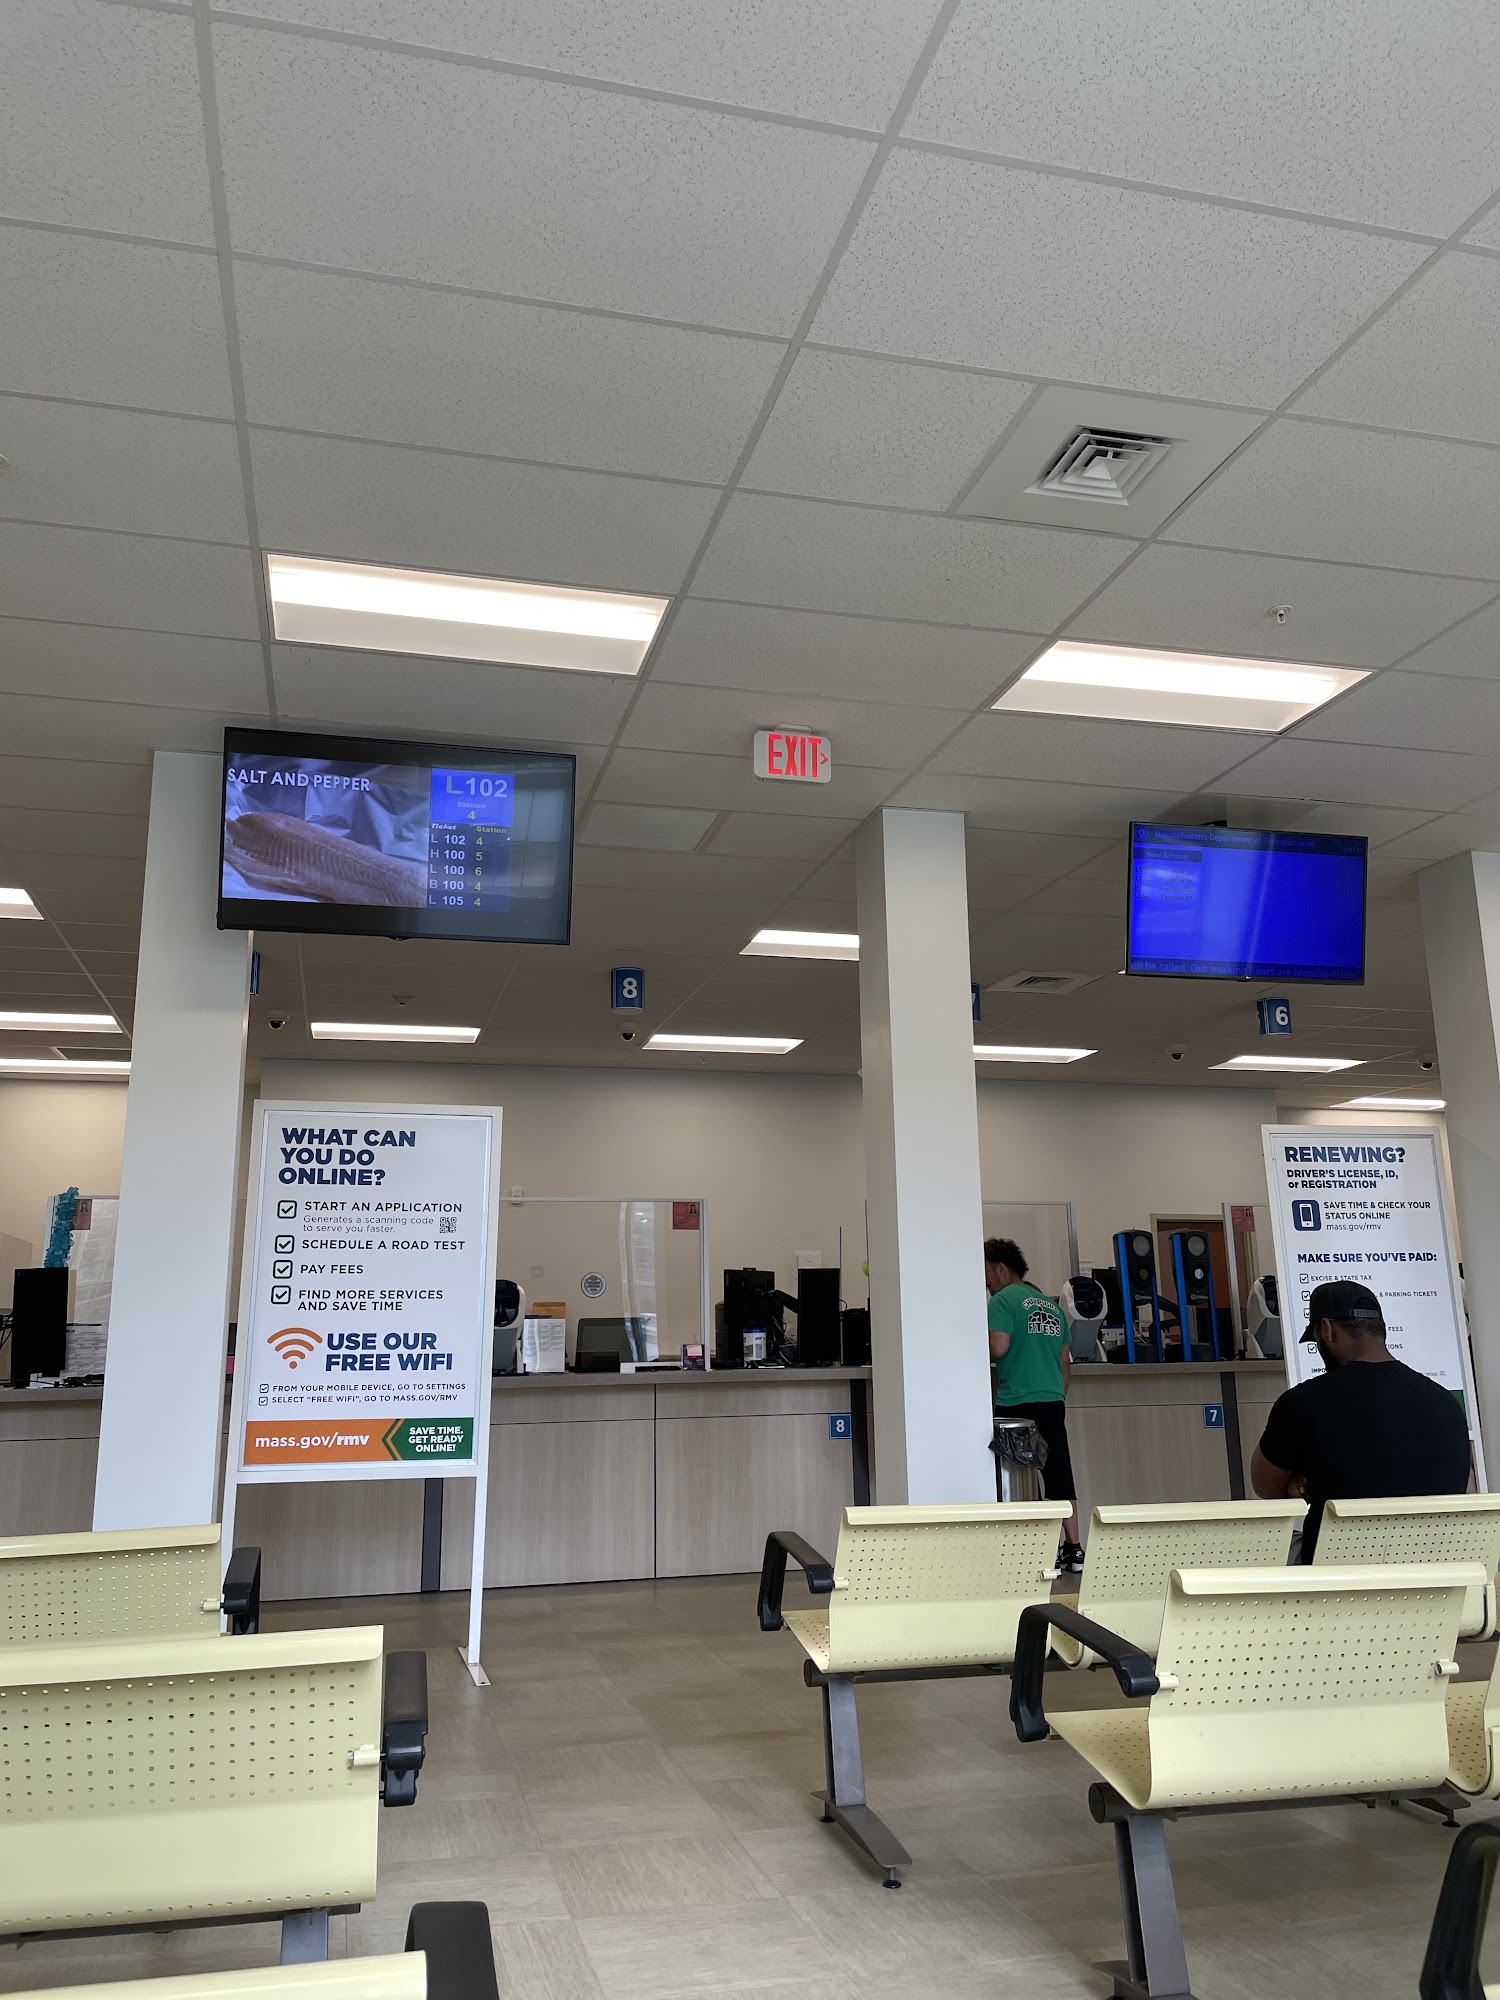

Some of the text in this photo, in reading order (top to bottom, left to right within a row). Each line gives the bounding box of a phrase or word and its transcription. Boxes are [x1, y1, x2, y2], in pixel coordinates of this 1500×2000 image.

[768, 733, 822, 778] EXIT
[228, 768, 370, 792] SALT AND PEPPER
[467, 810, 476, 820] 4
[476, 826, 507, 834] Station
[444, 834, 466, 845] 102
[476, 836, 484, 846] 4
[1154, 830, 1208, 841] Massachusetts
[1209, 833, 1254, 846] Department
[444, 850, 466, 860] 100
[476, 852, 483, 861] 5
[1146, 851, 1189, 861] Now Serving
[444, 865, 465, 875] 100
[475, 867, 482, 876] 6
[443, 880, 464, 891] 100
[474, 882, 482, 892] 4
[442, 896, 464, 906] 105
[474, 898, 481, 907] 4
[1145, 962, 1156, 971] be
[1190, 964, 1208, 973] Our
[622, 977, 638, 998] 8
[1276, 1006, 1288, 1026] 6
[281, 1128, 416, 1148] WHAT CAN
[280, 1147, 375, 1166] YOU DO
[1284, 1146, 1406, 1163] RENEWING?
[278, 1167, 386, 1186] ONLINE?
[1337, 1169, 1383, 1180] LICENSE,
[1385, 1170, 1399, 1180] ID,
[1301, 1180, 1377, 1189] REGISTRATION
[304, 1201, 462, 1213] START AN APPLICATION
[1323, 1201, 1431, 1209] SAVE TIME & CHECK YOUR
[303, 1214, 353, 1224] Generates
[364, 1216, 407, 1225] scanning
[410, 1216, 434, 1225] code
[1325, 1212, 1391, 1220] STATUS ONLINE
[303, 1224, 313, 1233] to
[345, 1226, 364, 1235] you
[366, 1224, 396, 1233] faster.
[1326, 1222, 1382, 1232] mass.gov/rmv
[302, 1240, 466, 1250] SCHEDULE A ROAD TEST
[1298, 1254, 1331, 1264] MAKE
[1332, 1253, 1363, 1263] SURE
[1408, 1252, 1438, 1262] PAID:
[300, 1264, 364, 1274] PAY FEES
[299, 1290, 444, 1300] FIND MORE SERVICES
[297, 1301, 403, 1311] AND SAVE TIME
[1028, 1321, 1061, 1336] FITESS
[327, 1332, 438, 1350] USE OUR
[325, 1353, 453, 1372] FREE WIFI
[300, 1384, 324, 1392] YOUR
[326, 1384, 359, 1392] MOBILE
[361, 1384, 395, 1392] DEVICE,
[397, 1383, 410, 1391] GO
[412, 1383, 424, 1391] TO
[272, 1396, 305, 1404] SELECT
[364, 1394, 377, 1402] GO
[378, 1394, 391, 1402] TO
[393, 1394, 458, 1402] MASS.GOV/RMV
[1210, 1410, 1218, 1422] 7
[409, 1426, 464, 1436] SAVE TIME.
[836, 1419, 845, 1433] 8
[255, 1432, 370, 1449] mass.gov/rmv
[408, 1434, 464, 1444] GET READY
[415, 1443, 456, 1453] ONLINE!
